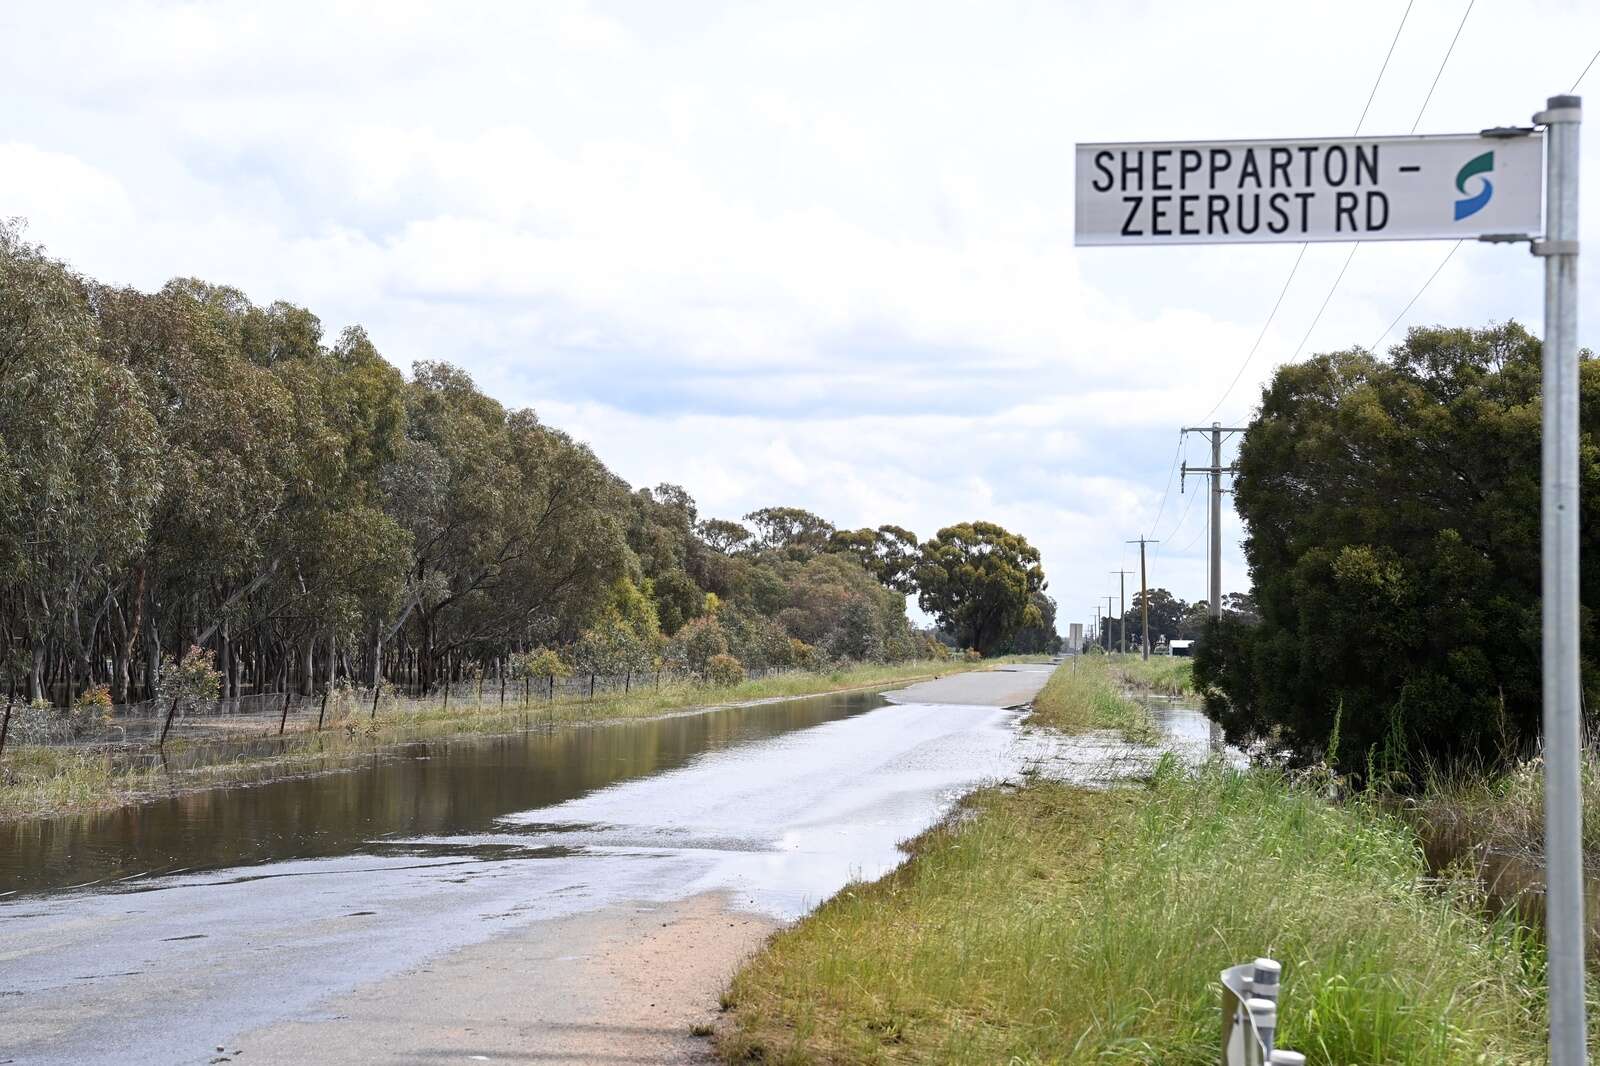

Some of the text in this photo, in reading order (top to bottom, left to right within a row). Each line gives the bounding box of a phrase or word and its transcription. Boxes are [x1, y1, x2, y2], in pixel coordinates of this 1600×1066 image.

[1092, 144, 1379, 193] SHEPPARTON
[1120, 190, 1389, 237] ZEERUST RD
